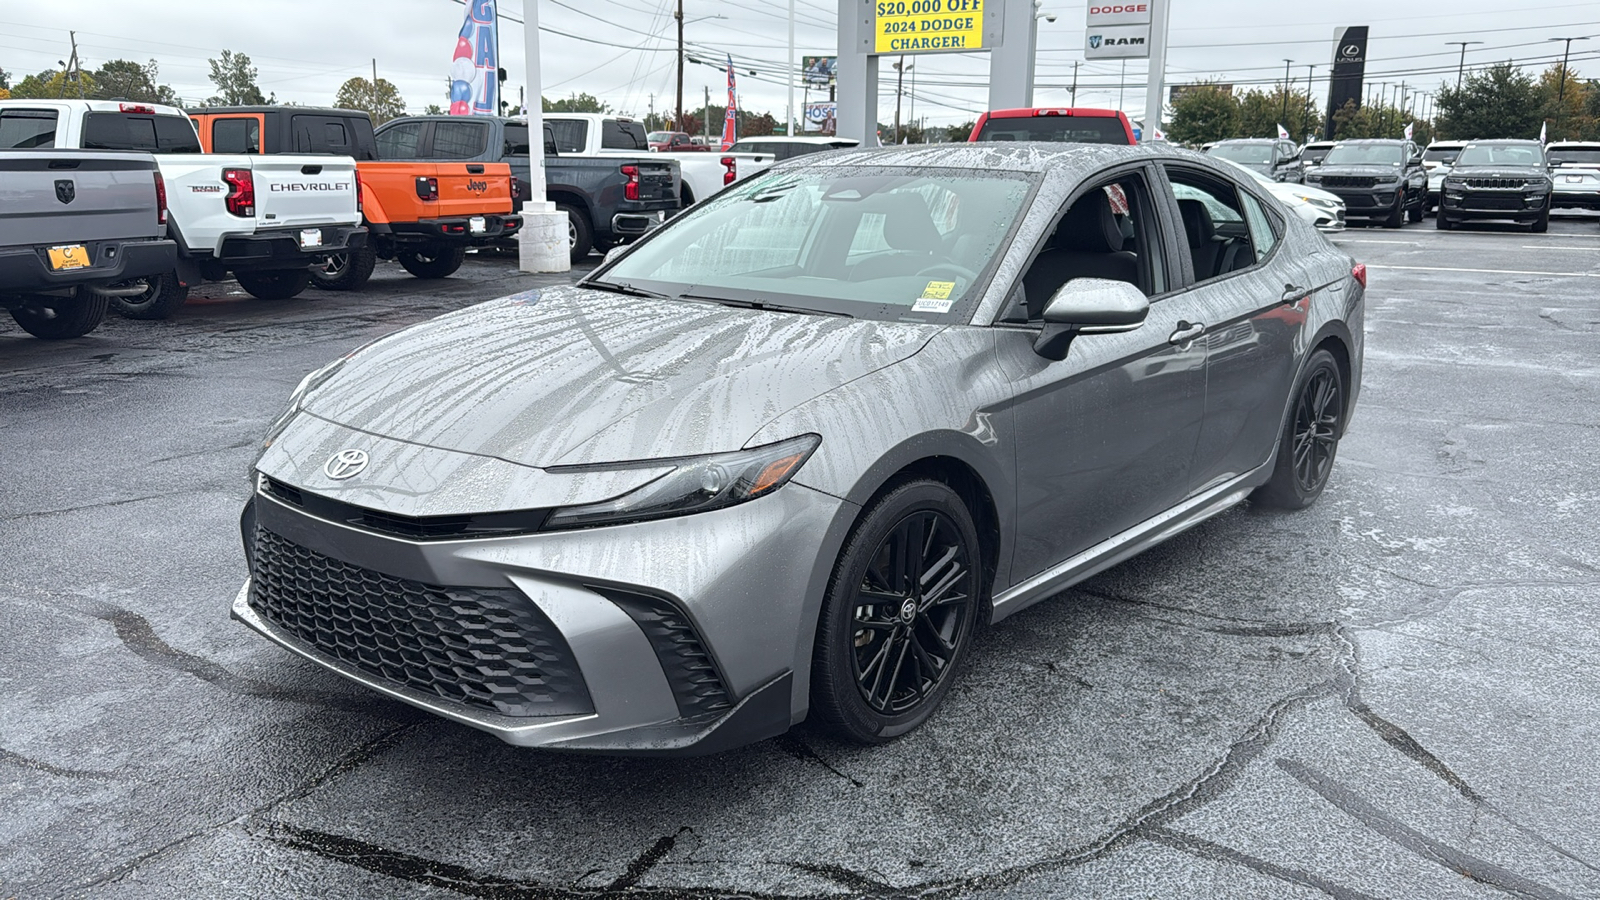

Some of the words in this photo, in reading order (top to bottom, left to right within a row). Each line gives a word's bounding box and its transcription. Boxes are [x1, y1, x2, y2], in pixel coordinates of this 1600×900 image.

[877, 0, 941, 17] $20,000
[947, 0, 981, 11] OFF
[1090, 4, 1147, 14] DODGE
[884, 21, 916, 33] 2024
[920, 17, 974, 32] DODGE
[890, 35, 965, 50] CHARGER!
[1104, 37, 1145, 46] RAM
[270, 182, 350, 192] CHEVROLET
[467, 178, 487, 193] Jeep
